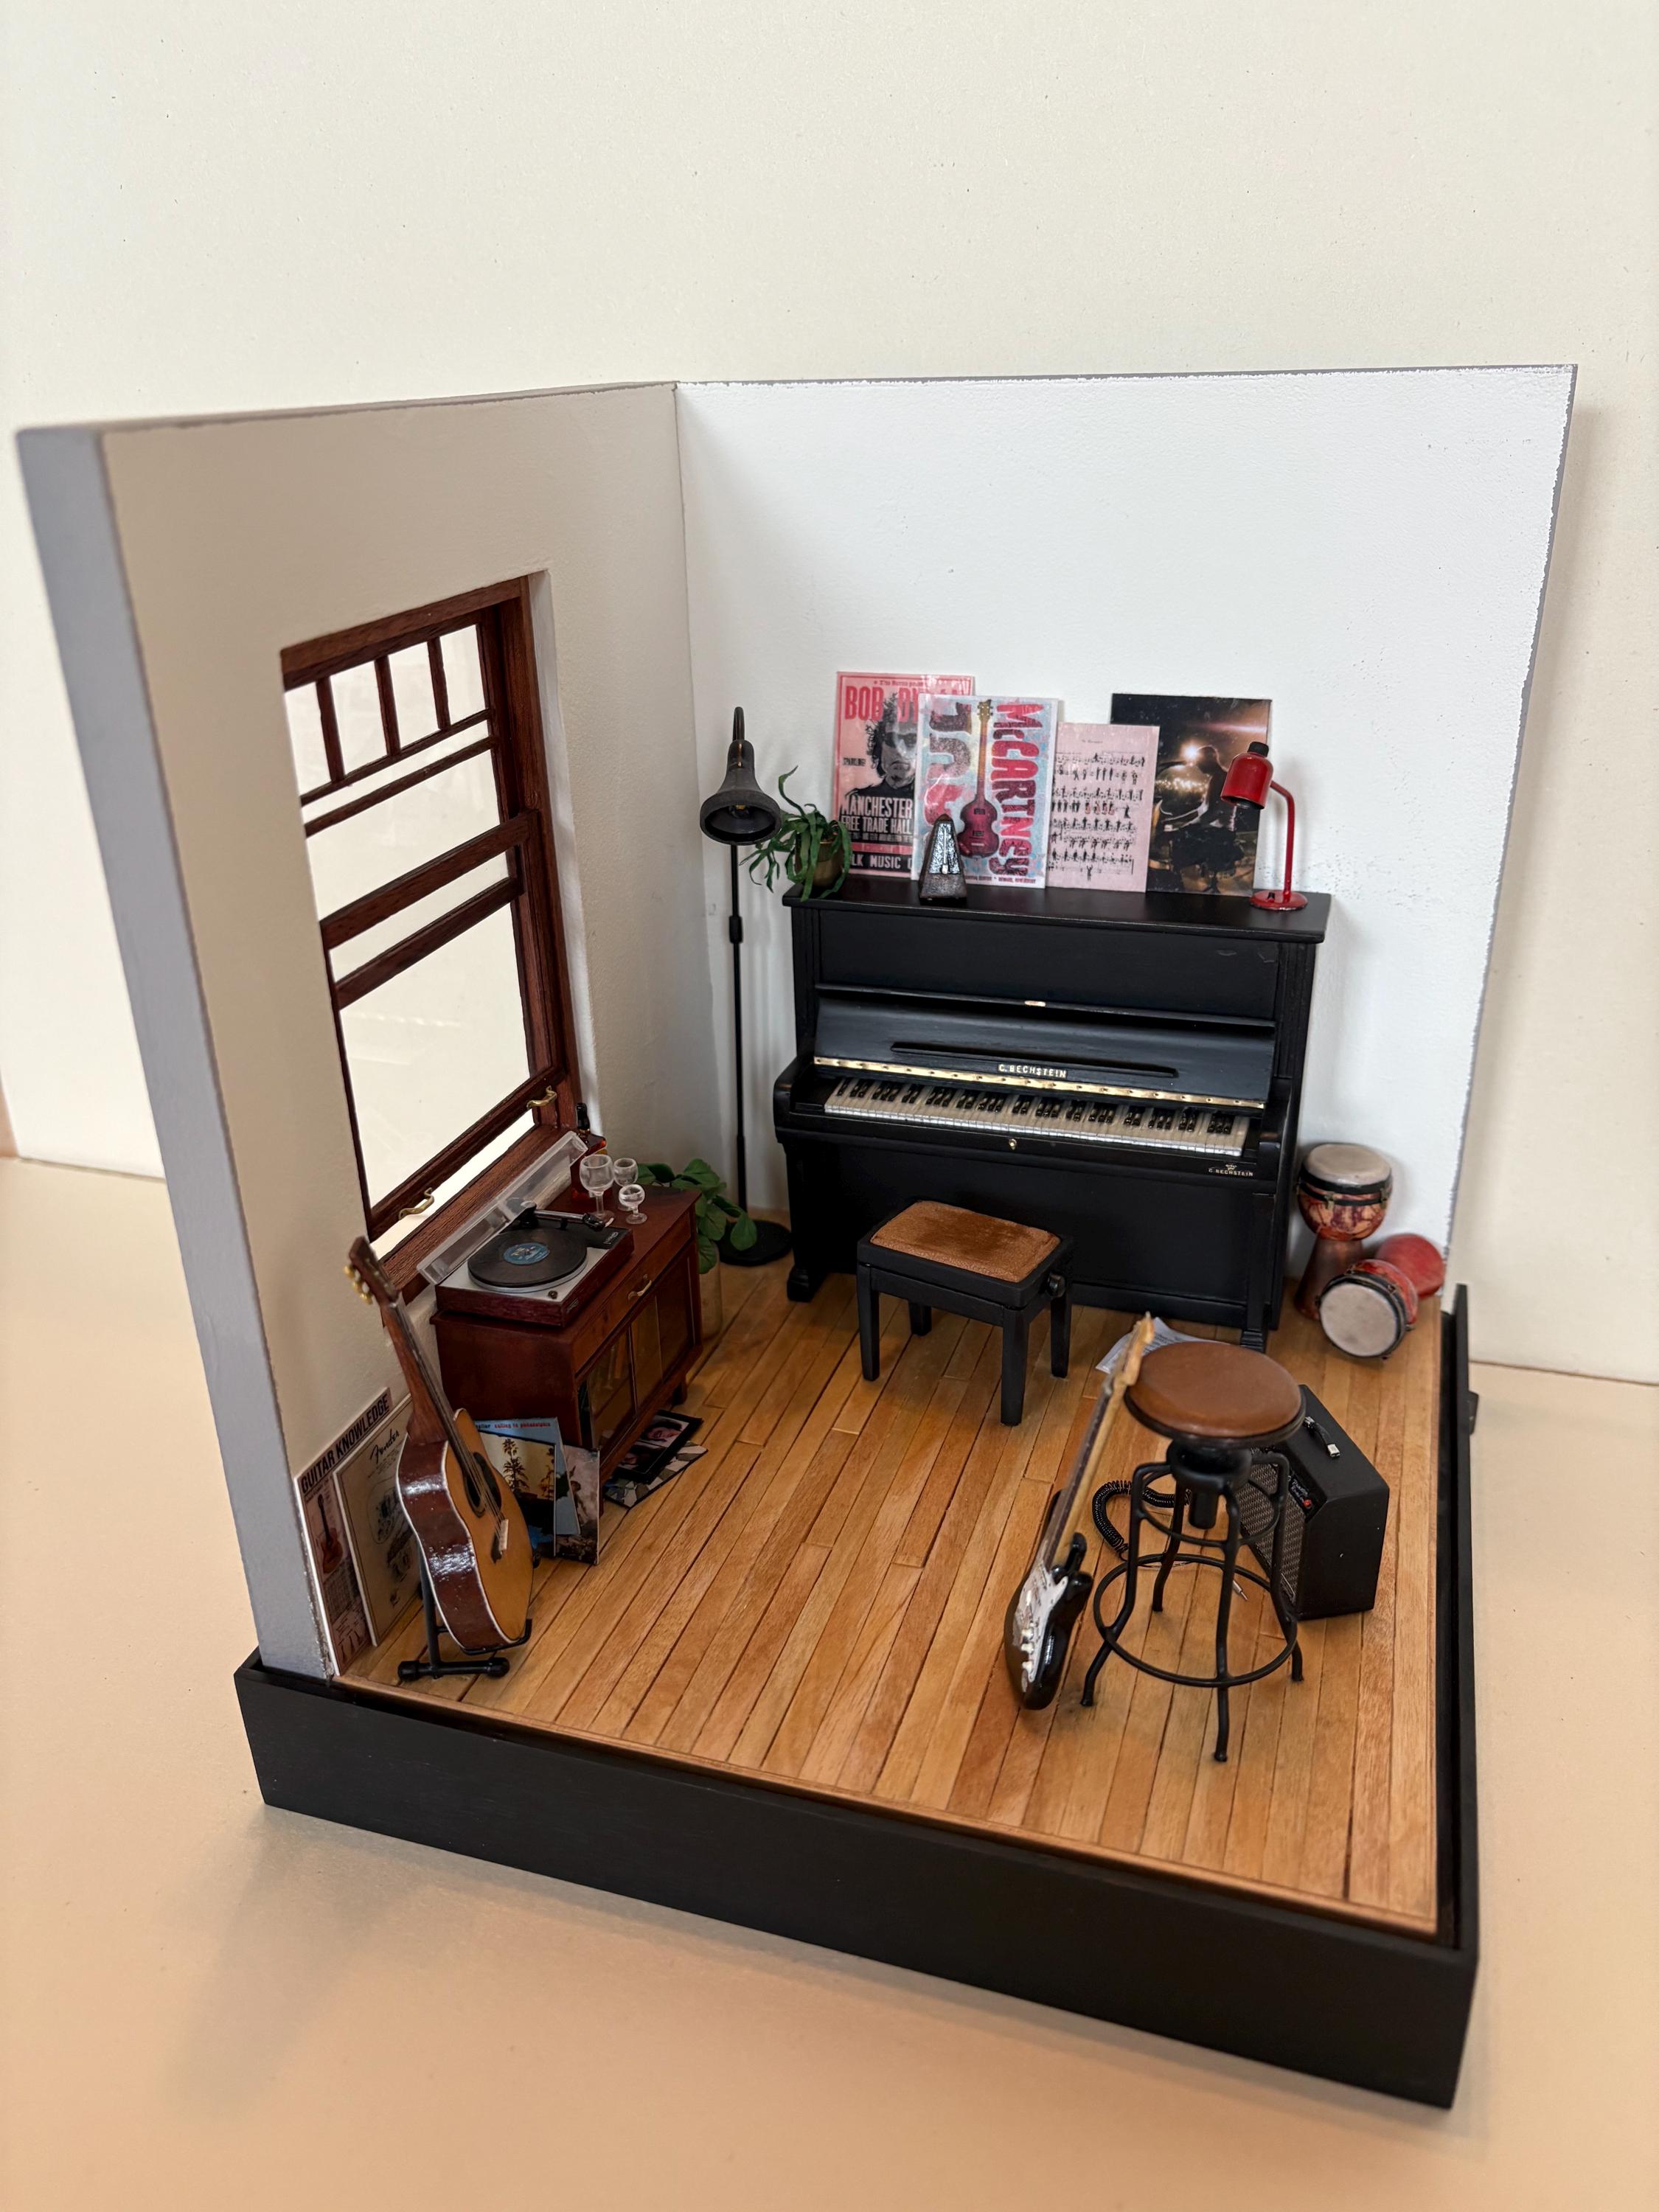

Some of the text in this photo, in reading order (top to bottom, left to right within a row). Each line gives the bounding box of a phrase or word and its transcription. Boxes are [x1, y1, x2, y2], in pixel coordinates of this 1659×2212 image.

[844, 686, 884, 721] BOB
[925, 702, 972, 829] AUL
[862, 816, 888, 833] TRADE
[891, 818, 912, 835] HALL
[870, 855, 901, 869] MUSIC
[1009, 1065, 1067, 1078] BECHSTEIN
[301, 1450, 335, 1494] GUITAR
[335, 1394, 389, 1460] KNOWLEDGE
[369, 1428, 400, 1464] Fender
